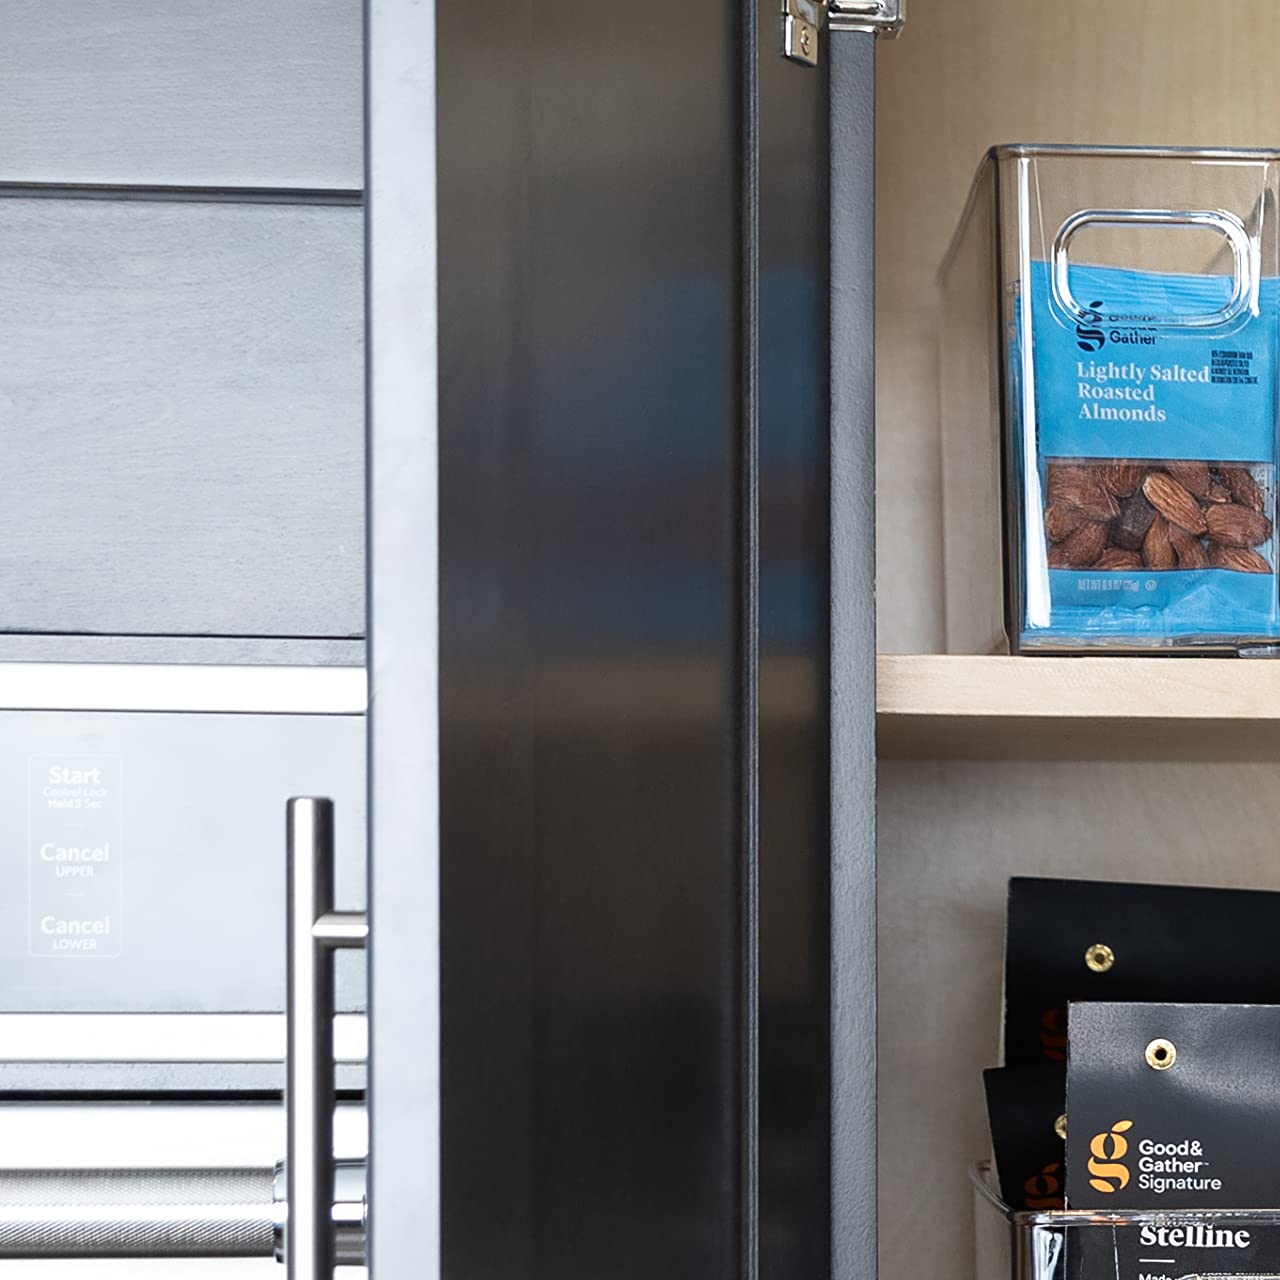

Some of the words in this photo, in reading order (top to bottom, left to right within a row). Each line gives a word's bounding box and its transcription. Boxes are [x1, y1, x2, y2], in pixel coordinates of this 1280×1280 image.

[1077, 361, 1146, 382] Lightly
[1150, 364, 1210, 384] Salted
[1077, 383, 1155, 402] Roasted
[1078, 403, 1167, 423] Almonds
[49, 766, 101, 784] Start
[40, 843, 109, 862] Cancel
[56, 865, 94, 877] UPPER
[40, 916, 110, 934] Cancel
[53, 938, 97, 950] LOWER
[1138, 1139, 1203, 1157] Good&
[1138, 1157, 1202, 1174] Gather
[1138, 1174, 1222, 1194] Signature
[1139, 1223, 1251, 1248] Stelline
